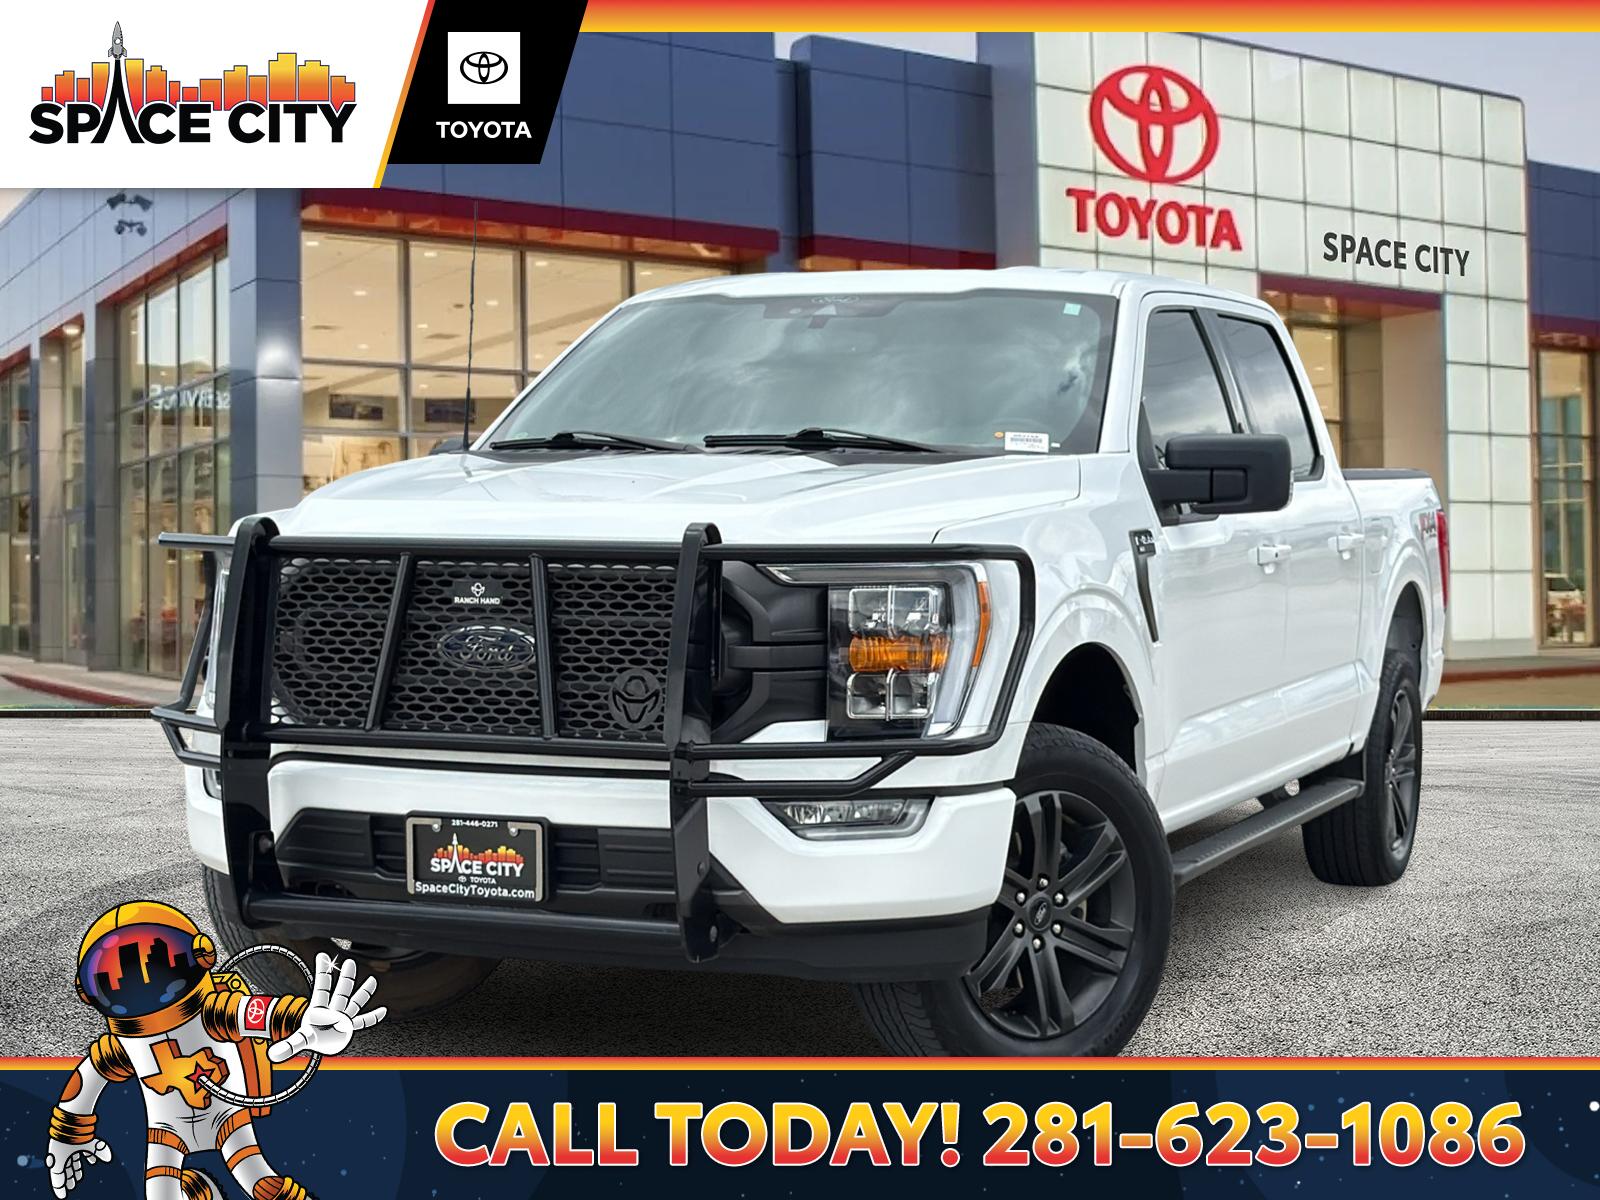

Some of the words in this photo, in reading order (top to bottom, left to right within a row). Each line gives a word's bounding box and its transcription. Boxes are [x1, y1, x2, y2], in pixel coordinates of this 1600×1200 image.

[1066, 187, 1242, 251] TOYOTA
[1323, 232, 1407, 270] SPACE
[1414, 244, 1470, 277] CITY
[454, 596, 479, 605] RANCH
[480, 597, 500, 605] HAND
[460, 635, 514, 661] Ford
[451, 819, 498, 828] 281-446-0271
[430, 845, 482, 875] SPACE
[486, 860, 524, 877] CITY
[415, 881, 535, 899] SpaceCityToyota.com
[470, 876, 497, 885] TOYOTA
